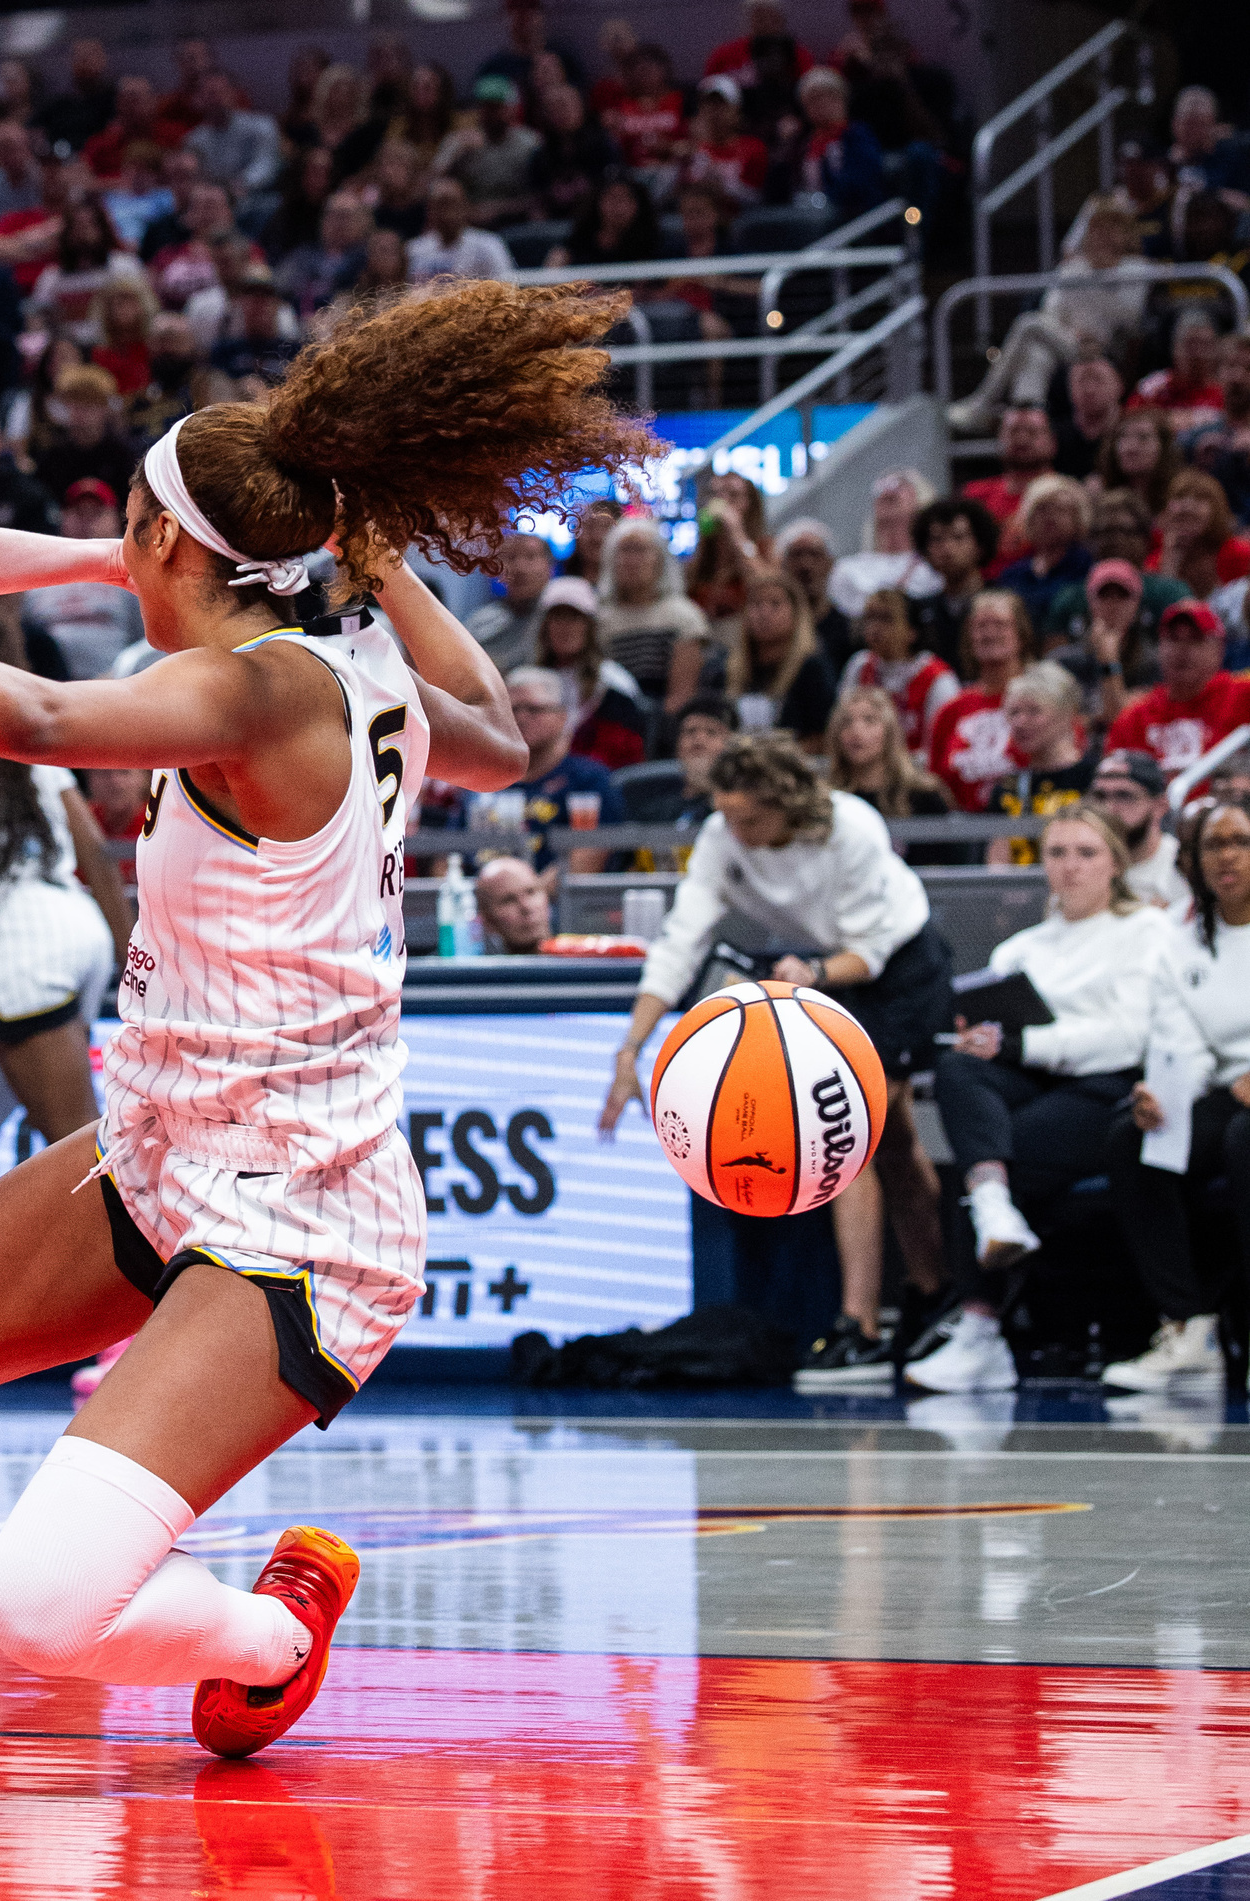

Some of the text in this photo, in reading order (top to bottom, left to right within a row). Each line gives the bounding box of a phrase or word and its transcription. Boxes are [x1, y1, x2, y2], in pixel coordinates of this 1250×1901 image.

[366, 701, 408, 830] 5
[740, 1091, 750, 1143] GAME BALL
[748, 1098, 757, 1138] OFFICIAL
[810, 1066, 856, 1209] Wilson
